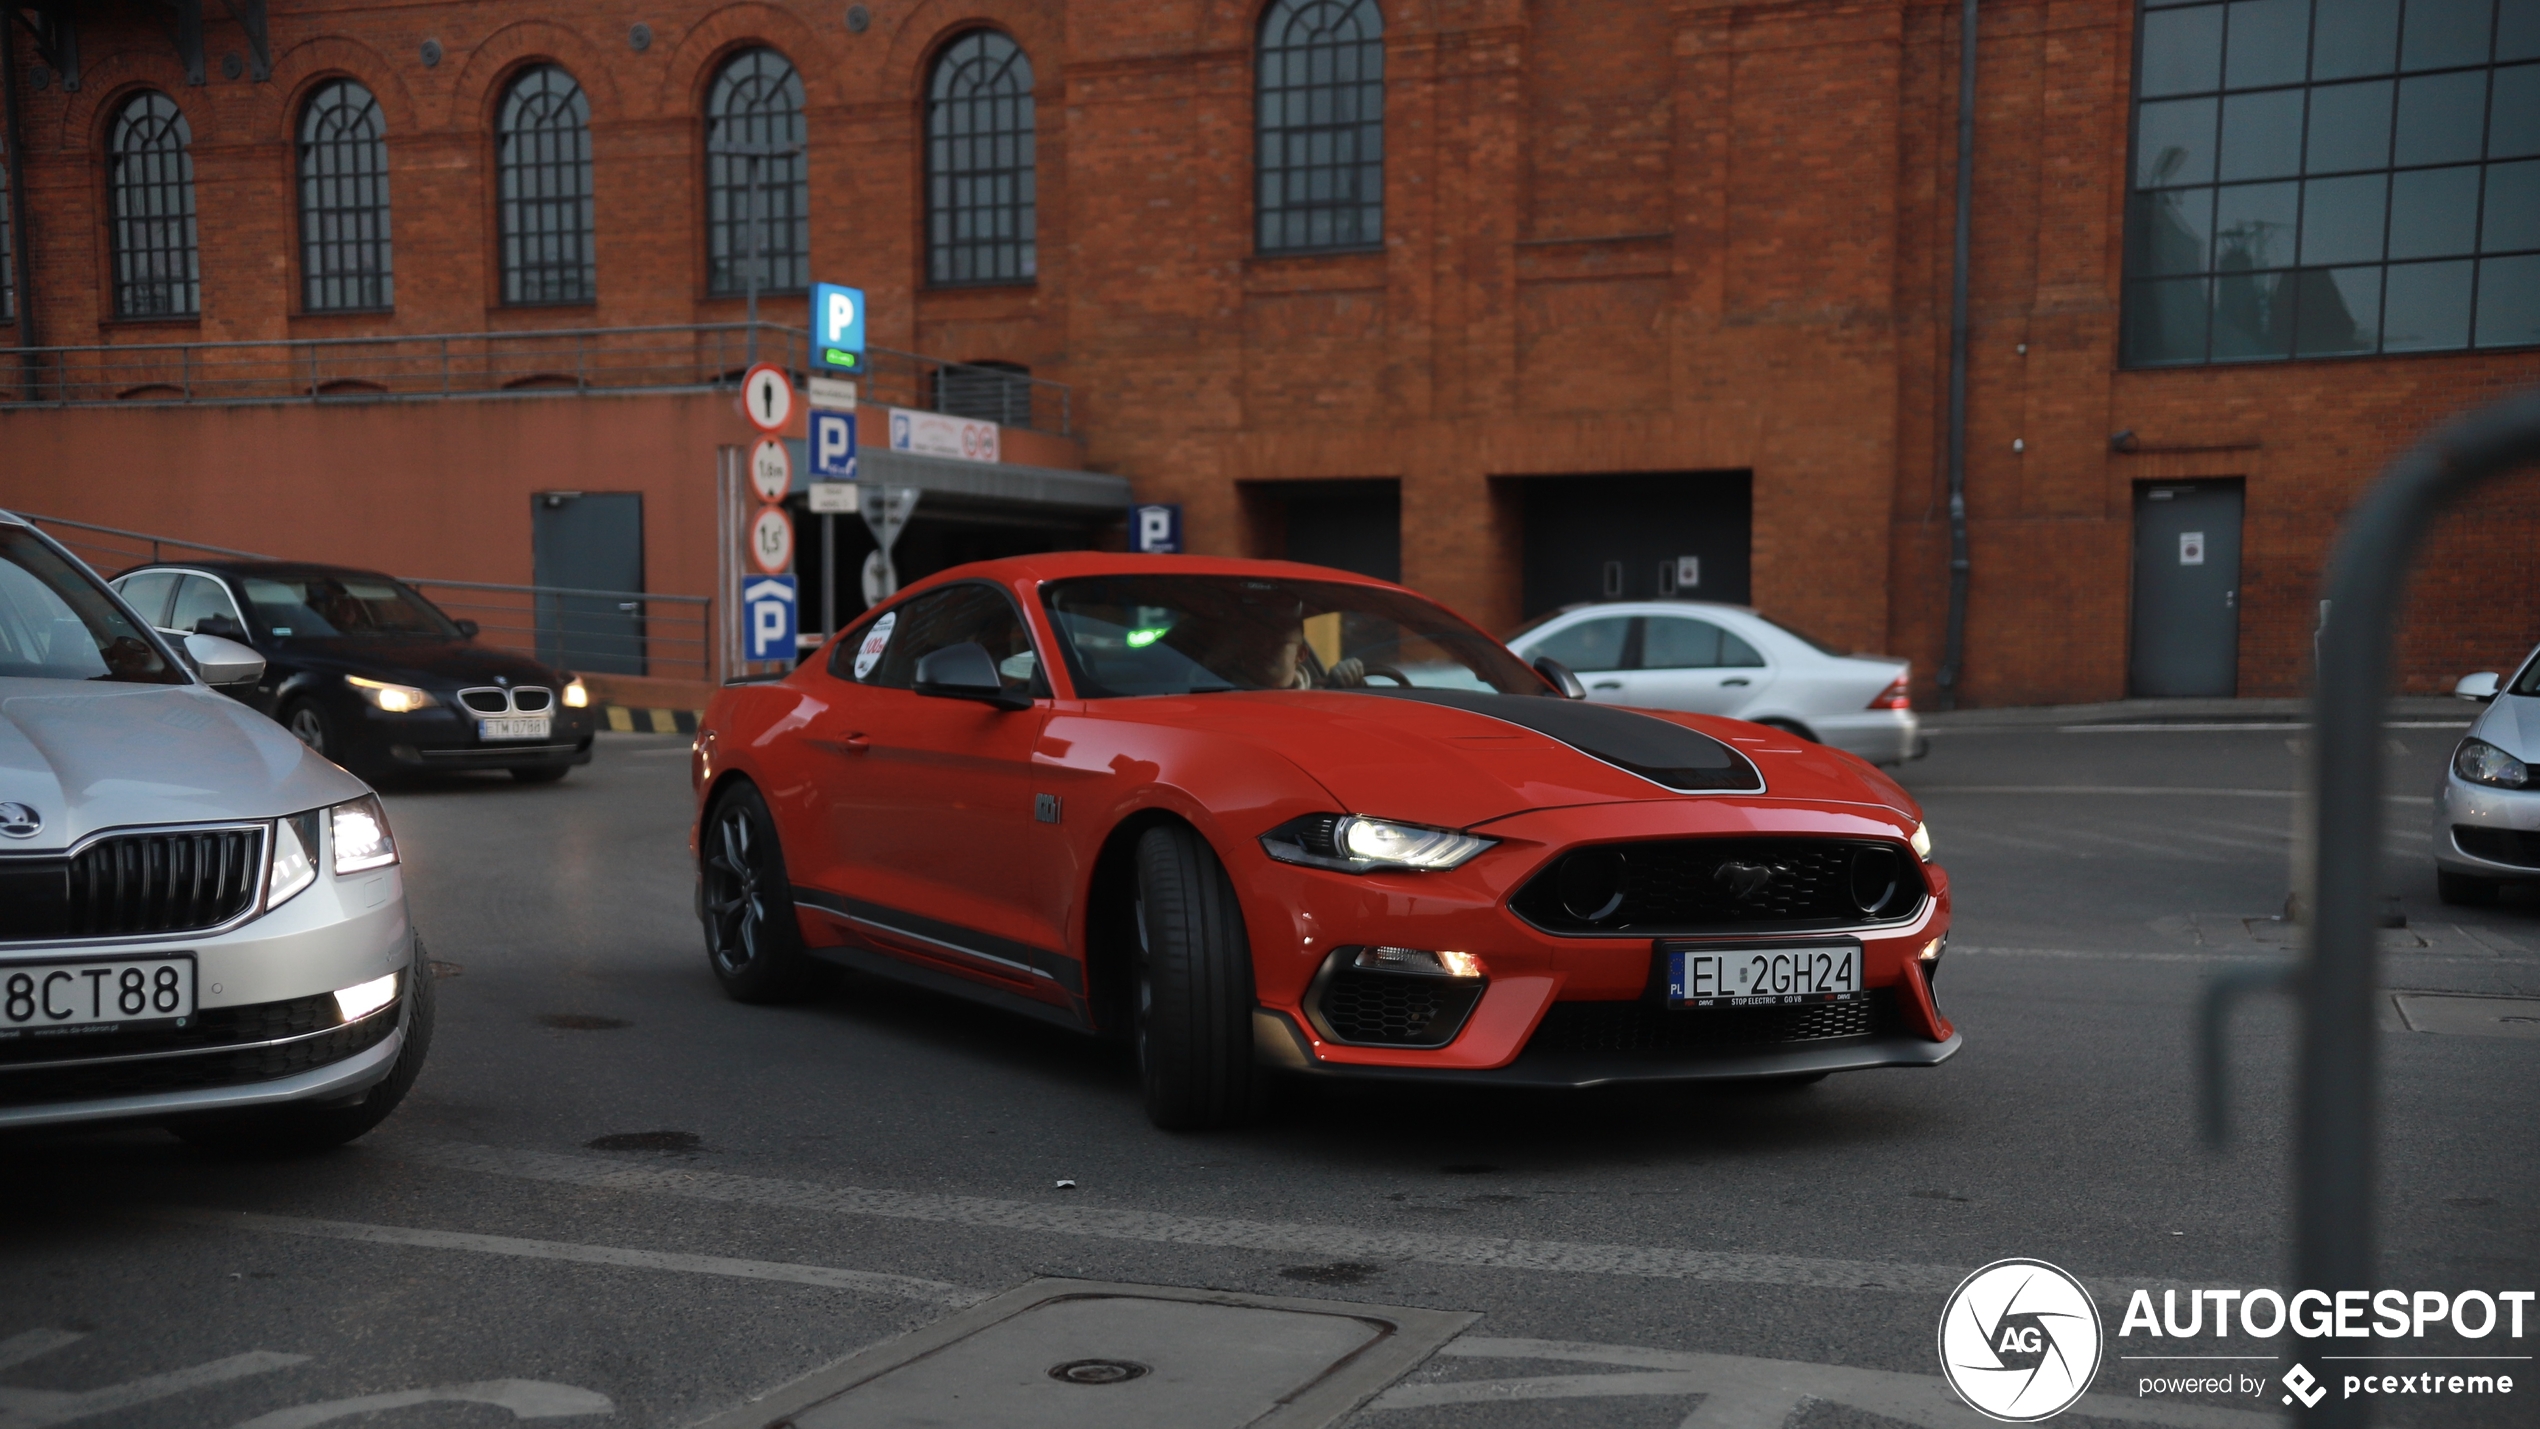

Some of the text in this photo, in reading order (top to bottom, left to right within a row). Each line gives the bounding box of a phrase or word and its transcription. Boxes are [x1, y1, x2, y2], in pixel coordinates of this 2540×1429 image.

[829, 293, 854, 342] P
[819, 416, 848, 471] P
[1140, 511, 1170, 549] P
[754, 600, 786, 656] P
[487, 720, 509, 735] ETM
[5, 965, 180, 1023] 8CT88
[1670, 982, 1683, 996] PL
[1692, 951, 1853, 998] EL 2GH24
[1731, 994, 1802, 1006] STOP ELECTRIC GO V8
